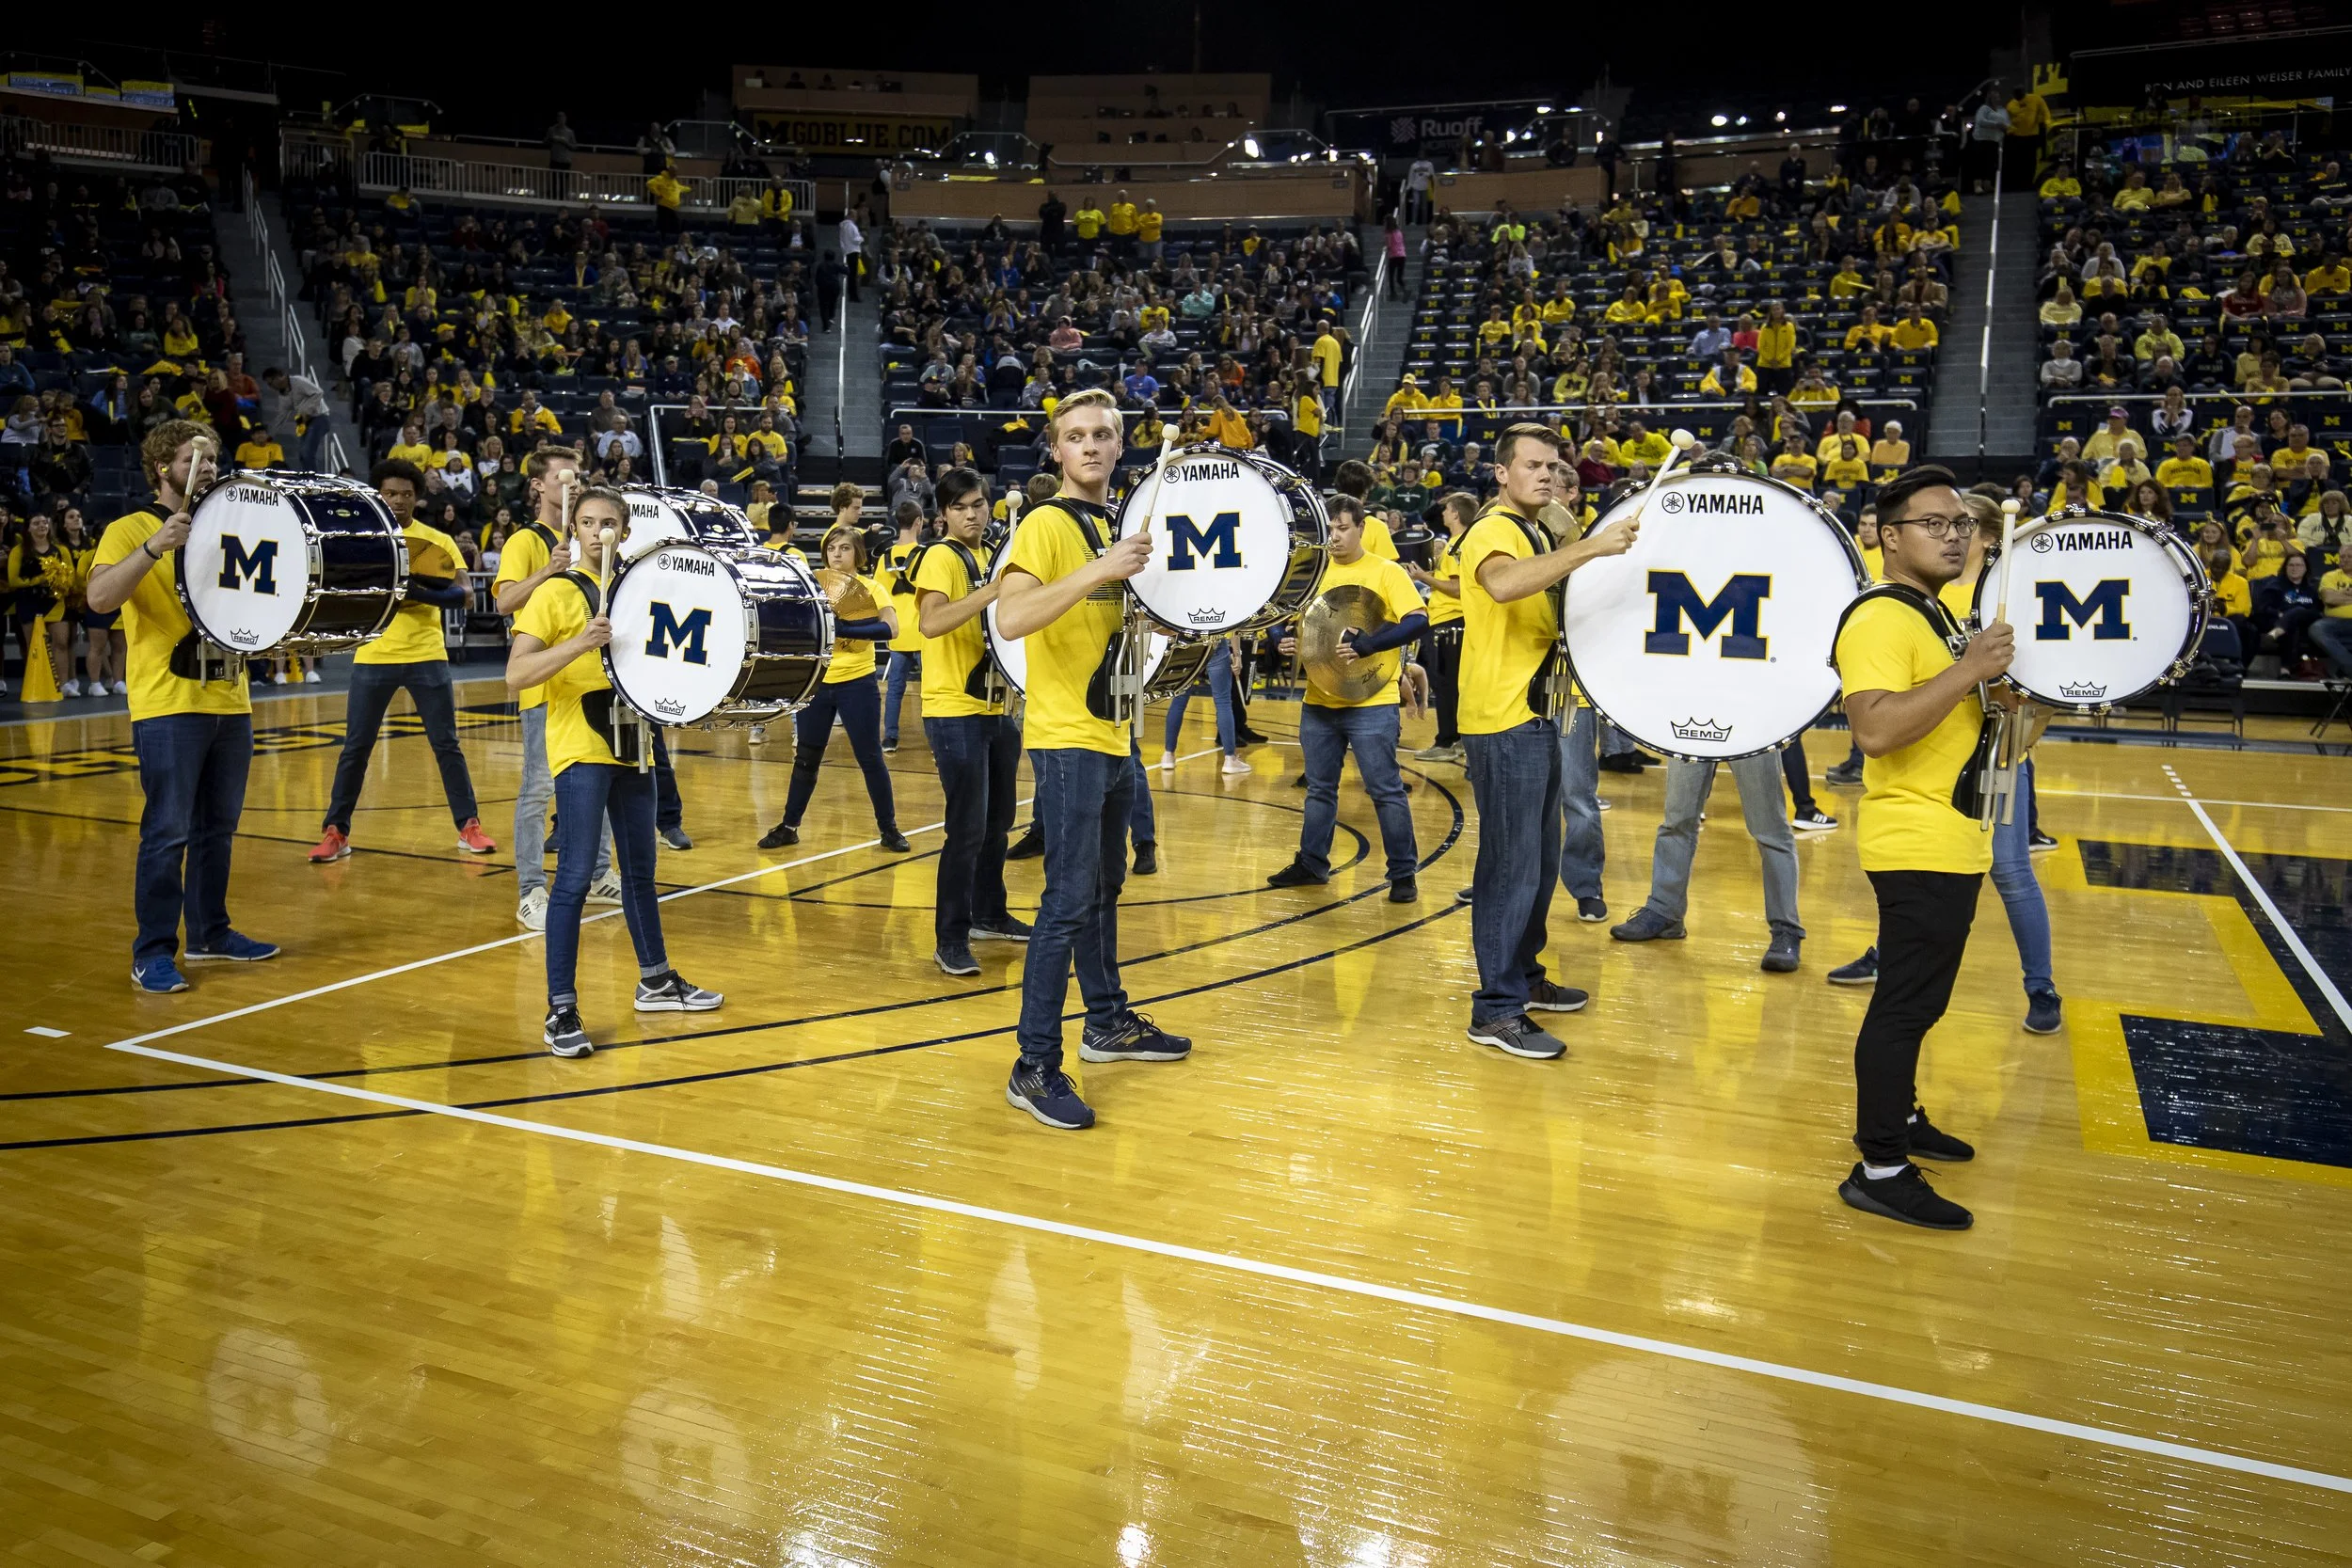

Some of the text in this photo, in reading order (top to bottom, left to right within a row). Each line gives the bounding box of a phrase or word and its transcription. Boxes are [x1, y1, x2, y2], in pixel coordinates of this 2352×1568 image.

[2176, 79, 2204, 91] AND
[2208, 75, 2250, 88] EILEEN
[2255, 71, 2303, 84] WEISER
[2308, 66, 2352, 80] FAMILY
[1421, 116, 1484, 137] Ruoff
[1181, 462, 1240, 482] YAMAHA
[238, 487, 279, 507] YAMAHA
[1687, 493, 1764, 515] YAMAHA
[628, 503, 660, 518] MAHA
[1165, 511, 1242, 572] M
[2056, 531, 2134, 551] YAMAHA
[218, 532, 278, 595] M
[672, 556, 715, 577] YAMAHA
[1643, 568, 1772, 660] M
[2034, 578, 2132, 641] M
[644, 600, 712, 666] M
[658, 705, 681, 714] REMO
[1678, 728, 1724, 739] REMO
